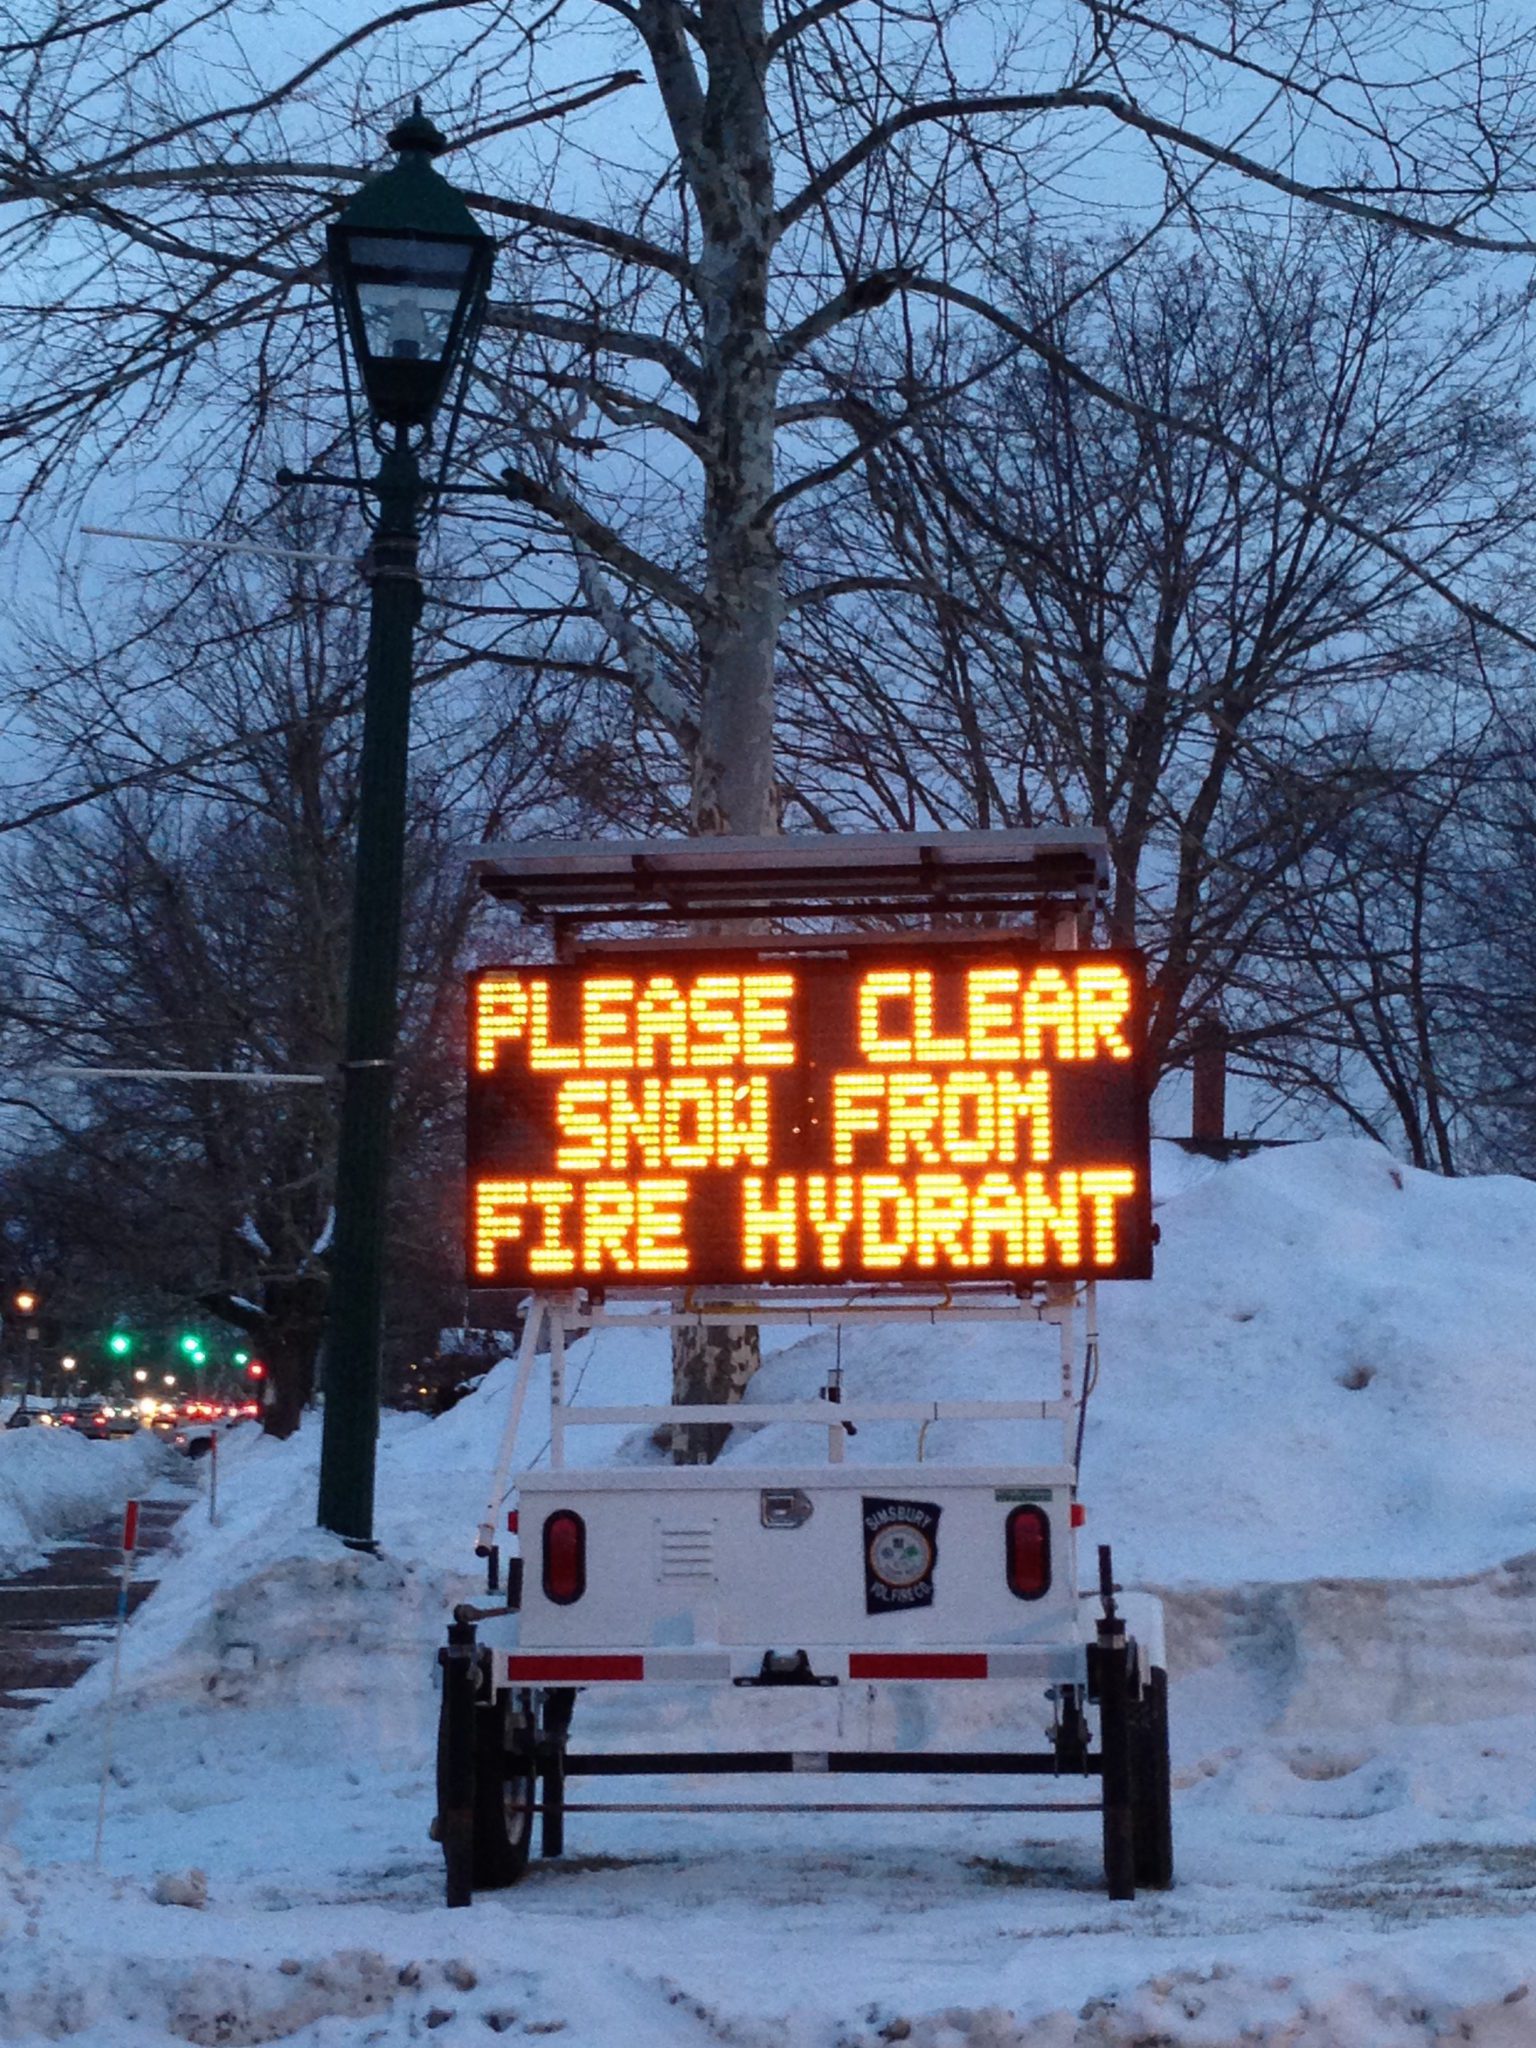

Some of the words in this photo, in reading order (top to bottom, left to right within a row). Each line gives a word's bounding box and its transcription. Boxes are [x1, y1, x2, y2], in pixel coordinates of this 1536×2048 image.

[476, 975, 796, 1071] PLEASE
[858, 965, 1132, 1063] CLEAR
[556, 1075, 770, 1170] SNOW
[832, 1070, 1052, 1166] FROM
[476, 1178, 690, 1273] FIRE
[741, 1169, 1135, 1269] HYDRANT
[865, 1506, 932, 1531] SIMSBURY
